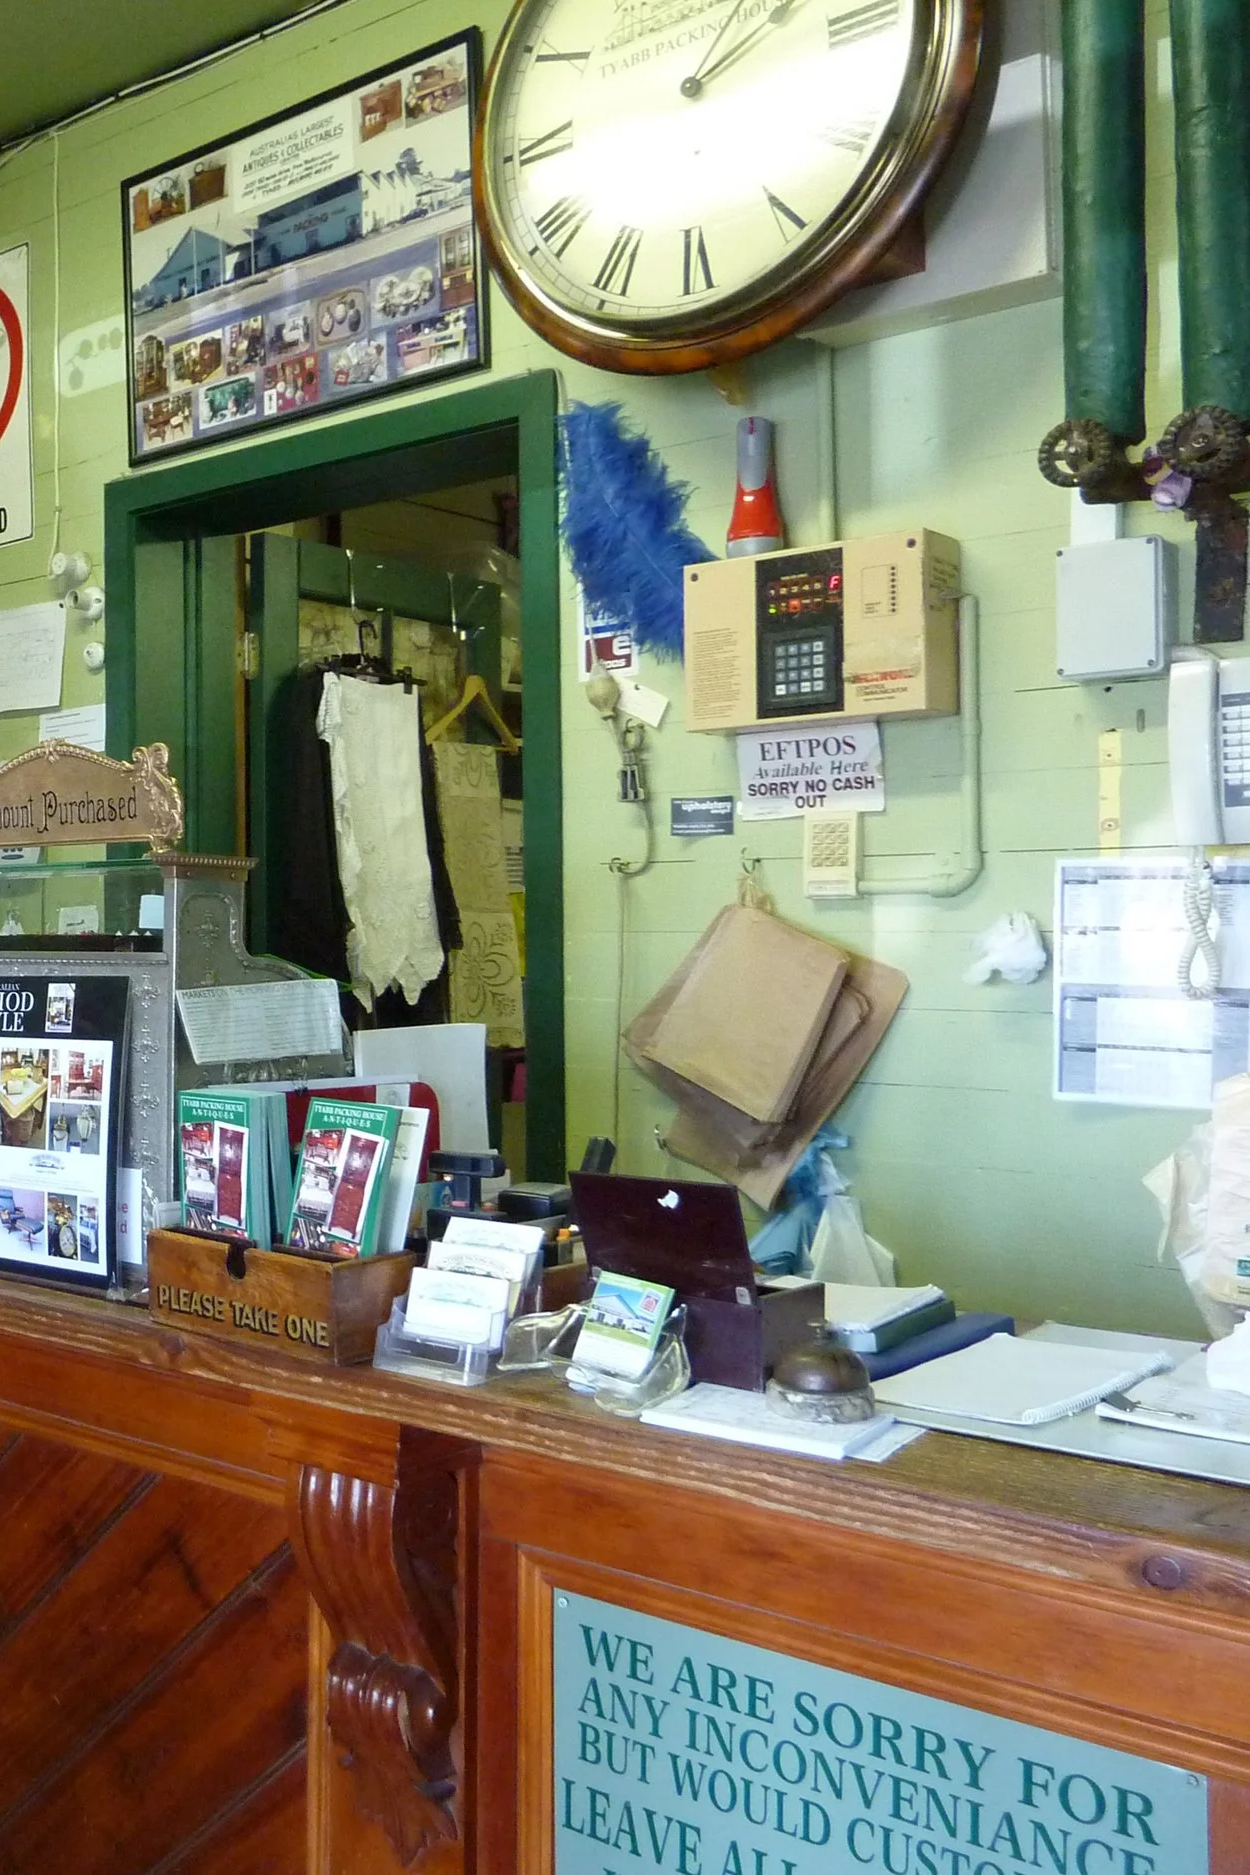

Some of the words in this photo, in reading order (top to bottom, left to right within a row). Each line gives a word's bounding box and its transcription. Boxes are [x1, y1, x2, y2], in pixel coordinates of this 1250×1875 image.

[599, 47, 651, 78] TYABB
[655, 15, 732, 57] PACKING
[242, 150, 279, 174] ANTIQUES
[286, 123, 344, 156] COLLECTABLES
[759, 735, 856, 761] EFTPOS
[748, 781, 799, 797] SORRY
[805, 779, 827, 792] NO
[832, 776, 875, 791] CASH
[753, 762, 822, 780] Available
[830, 760, 869, 775] Here
[37, 787, 138, 834] Purchased
[795, 795, 827, 809] OUT
[192, 1108, 235, 1120] ANTIQUES
[200, 1101, 225, 1110] PACKING
[225, 1104, 244, 1112] HOUSE
[322, 1115, 371, 1128] ANTIQUES
[334, 1107, 361, 1118] PACKING
[361, 1111, 387, 1121] HOUSE
[158, 1284, 225, 1321] PLEASE
[230, 1302, 279, 1336] TAKE
[285, 1315, 330, 1347] ONE
[579, 1623, 654, 1686] WE
[670, 1655, 776, 1724] ARE
[792, 1690, 996, 1792] SORRY
[1017, 1757, 1160, 1846] FOR
[578, 1676, 671, 1740] ANY
[685, 1709, 1156, 1875] INCONVENIANCE
[579, 1721, 655, 1785] BUT
[668, 1751, 832, 1846] WOULD
[561, 1777, 702, 1875] LEAVE
